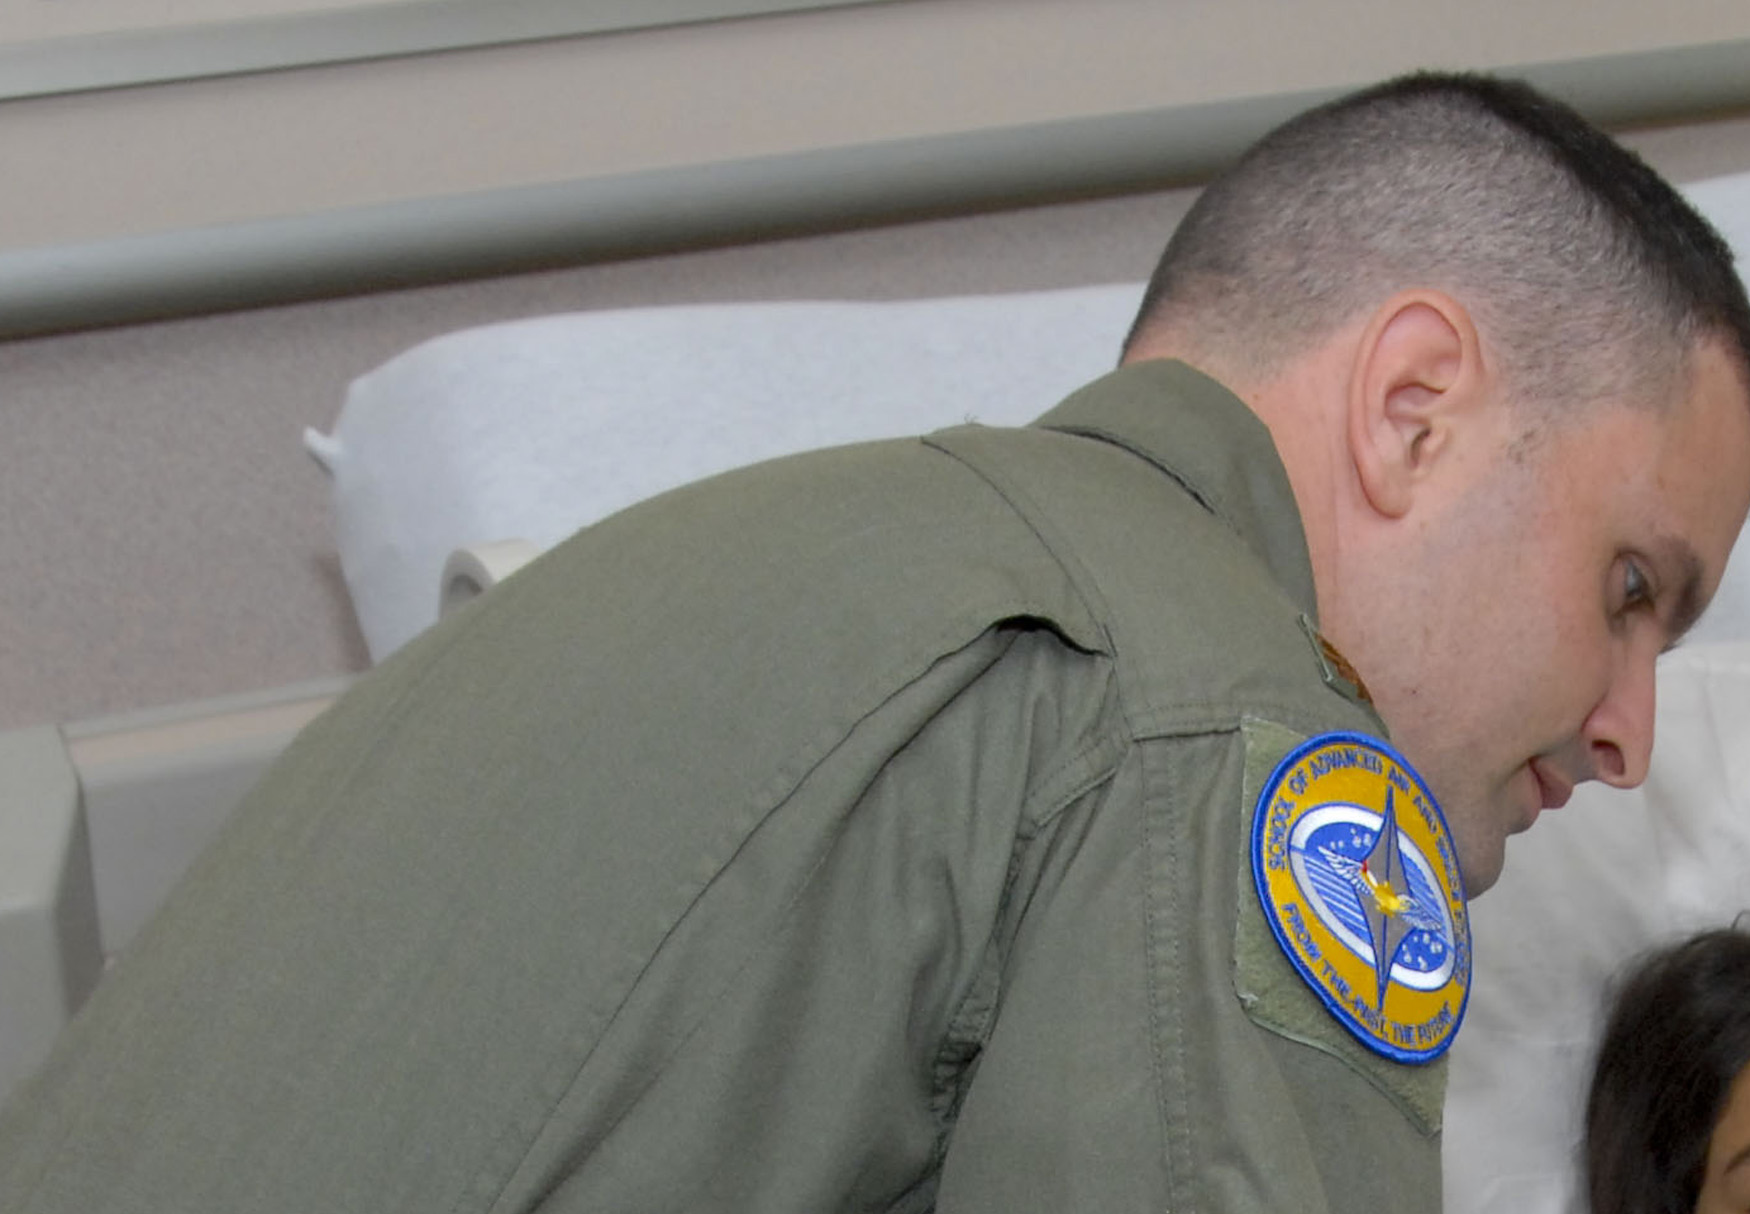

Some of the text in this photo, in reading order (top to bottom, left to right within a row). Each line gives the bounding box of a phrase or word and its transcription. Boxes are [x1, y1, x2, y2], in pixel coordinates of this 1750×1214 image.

[1269, 797, 1296, 872] SCHOOL
[1289, 768, 1308, 795] OF
[1309, 748, 1383, 781] ADVANCED
[1283, 903, 1322, 962] FROM
[1322, 959, 1352, 999] THE
[1391, 1021, 1416, 1046] THE
